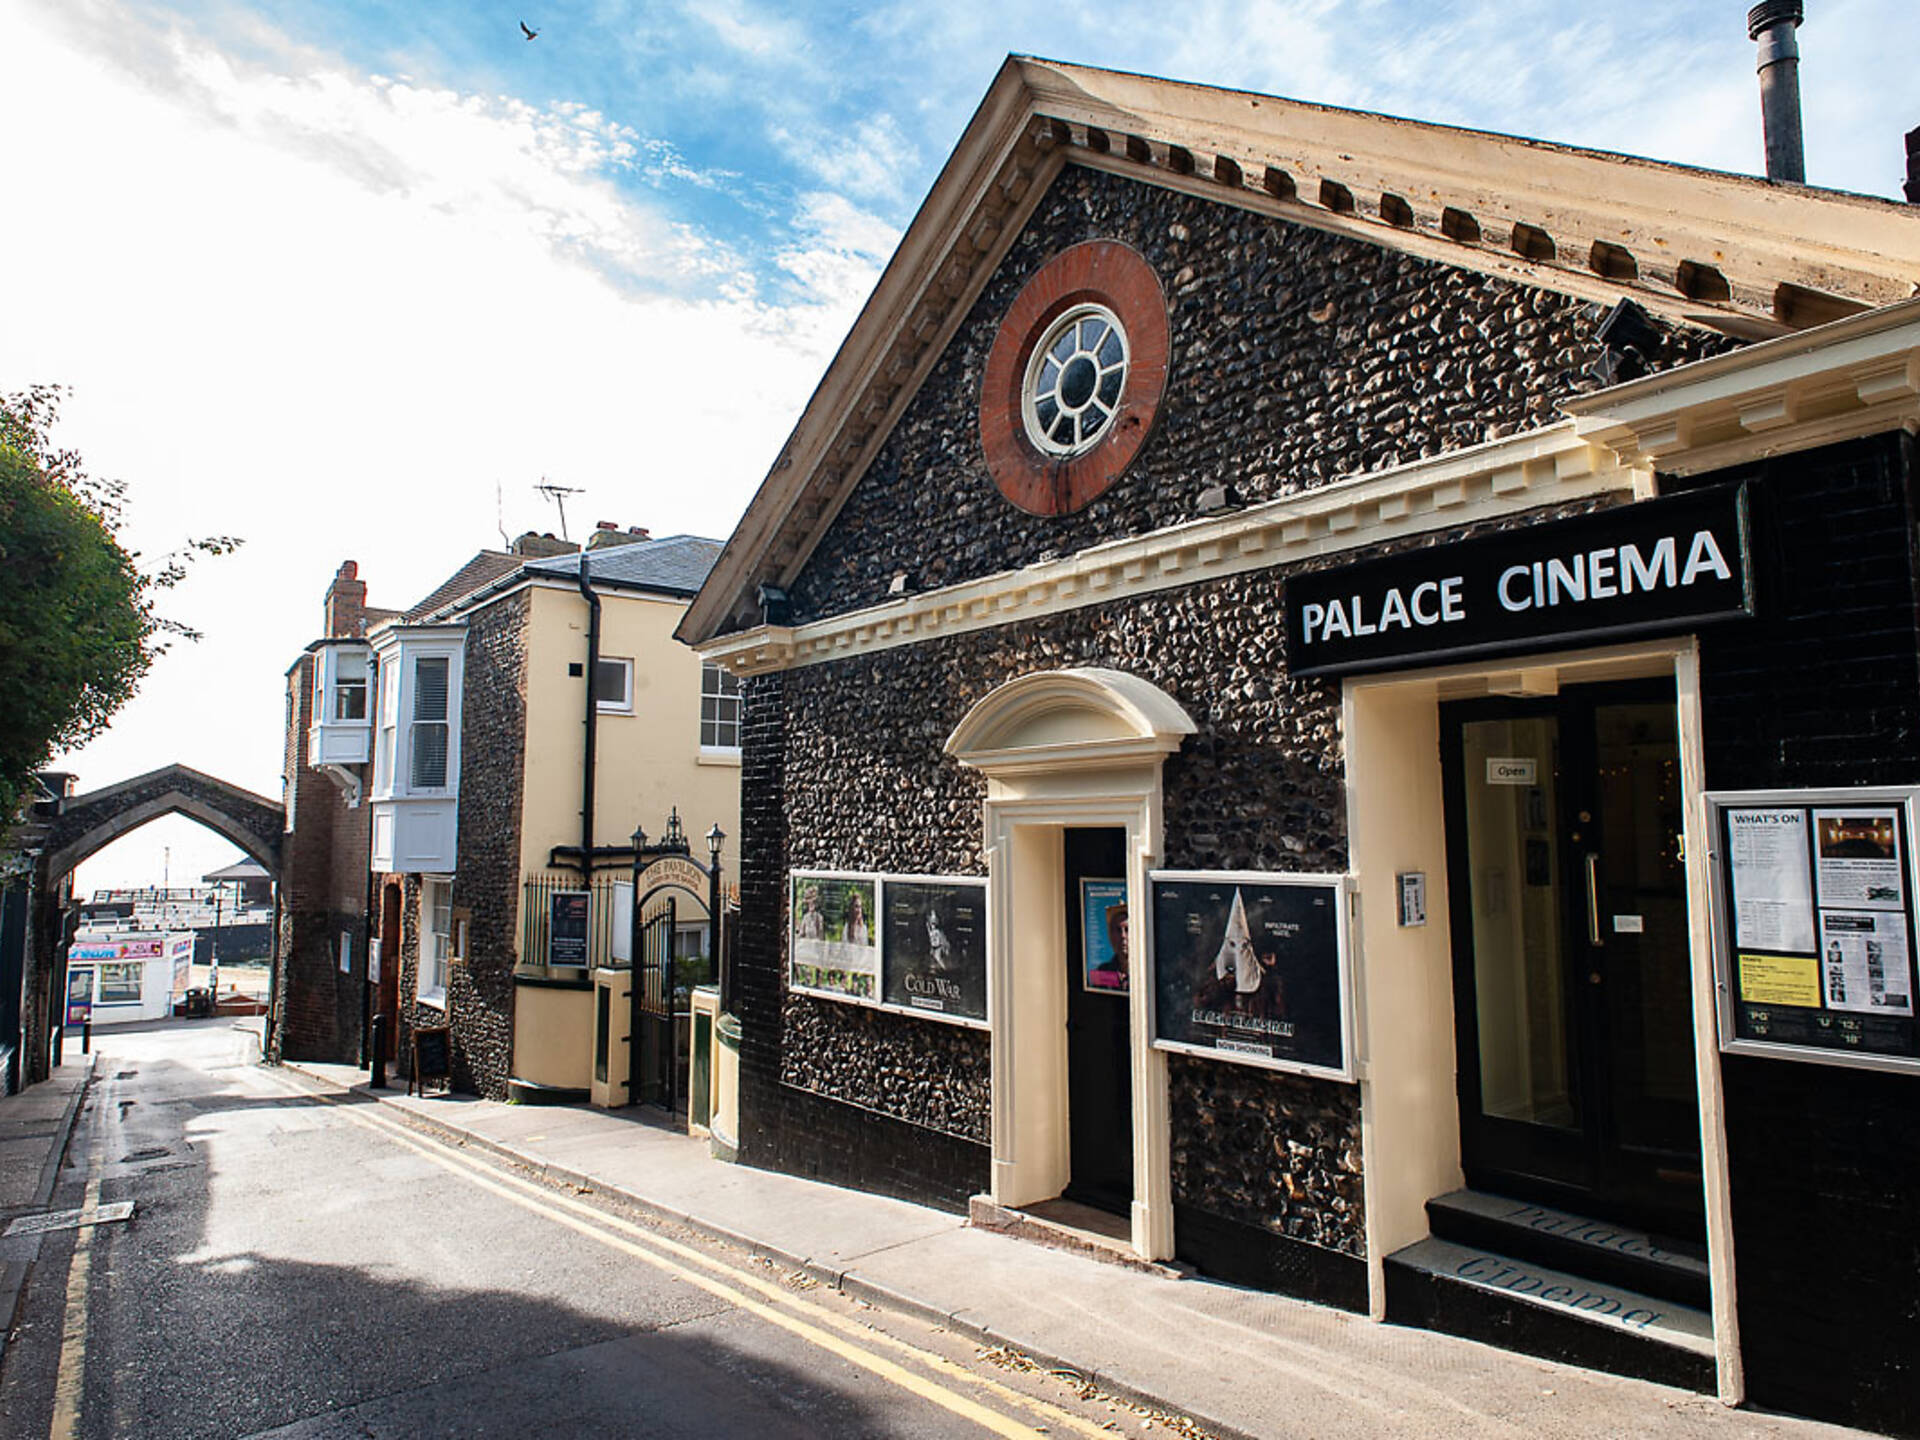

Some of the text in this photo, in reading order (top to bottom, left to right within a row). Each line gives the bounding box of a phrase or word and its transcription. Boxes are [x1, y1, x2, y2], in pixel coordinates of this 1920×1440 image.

[1303, 530, 1732, 644] PALACE CINEMA
[1498, 765, 1526, 778] Open
[1735, 814, 1800, 824] WHAT'S ON
[1456, 1255, 1667, 1329] Cinema
